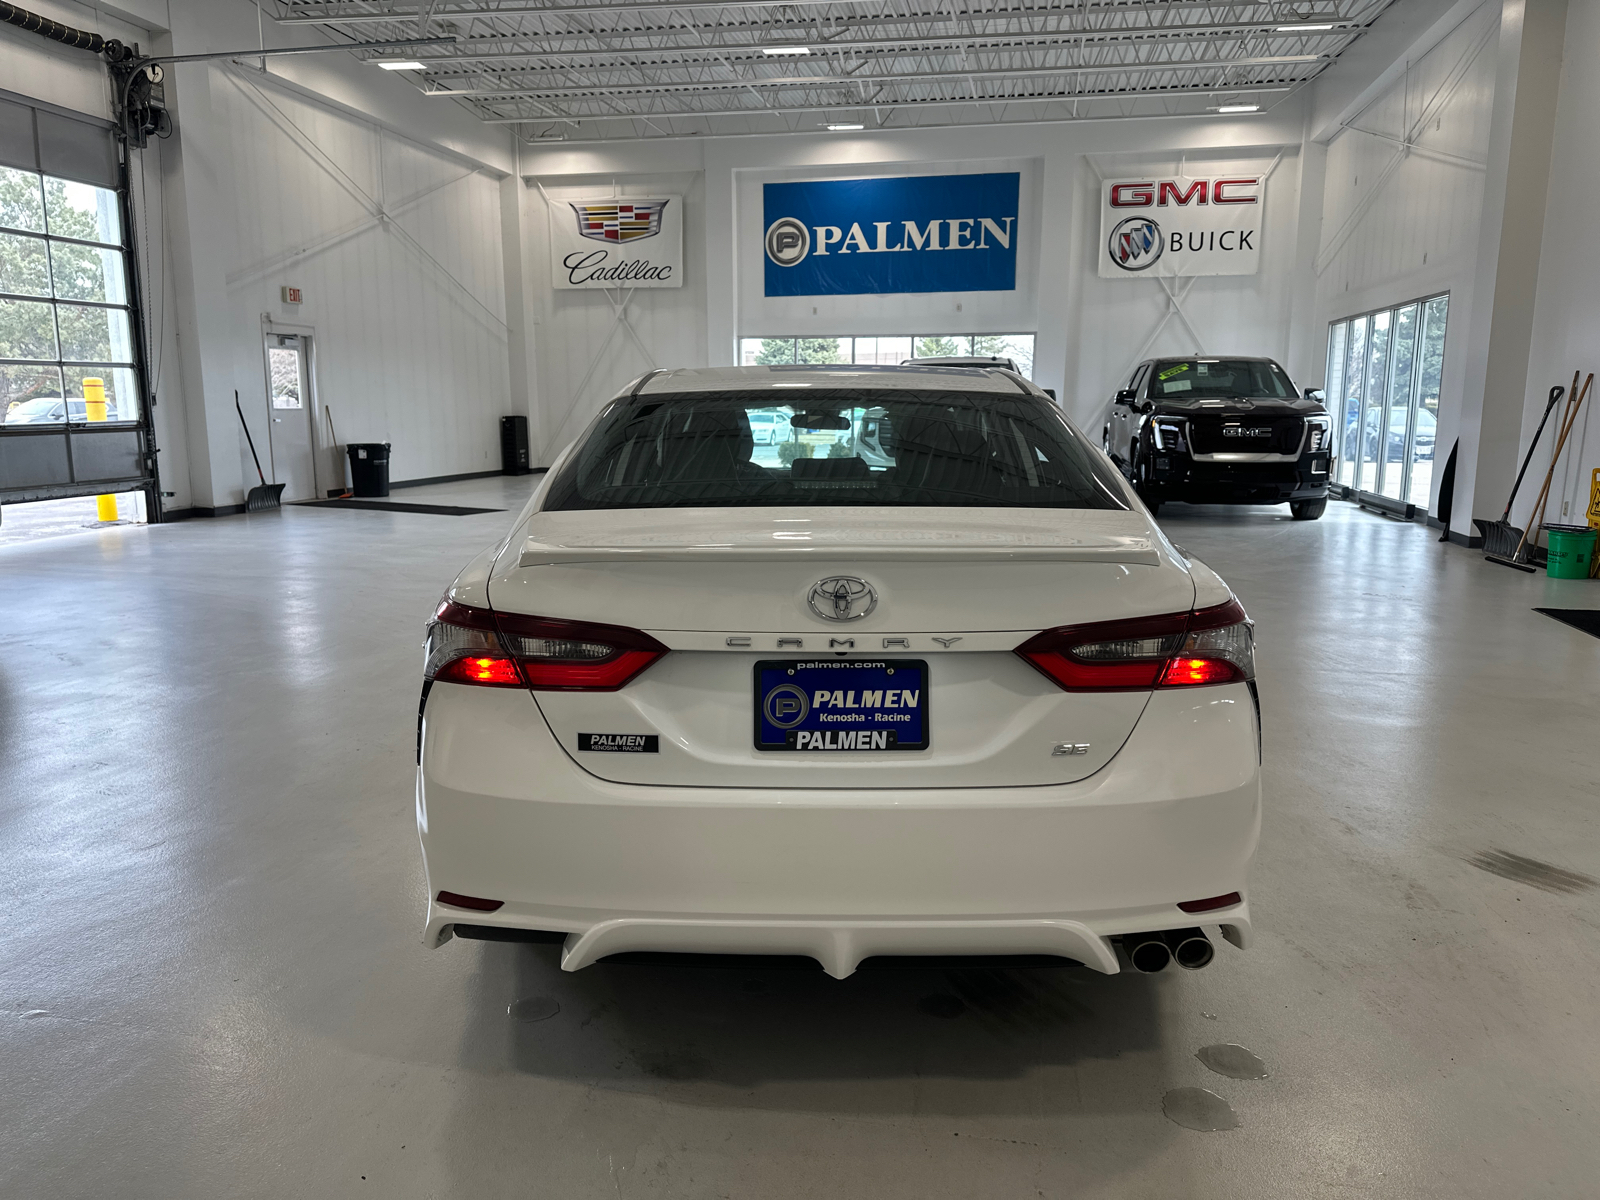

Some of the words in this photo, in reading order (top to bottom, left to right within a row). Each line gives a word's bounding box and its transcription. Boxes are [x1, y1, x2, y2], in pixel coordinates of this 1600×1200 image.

[1109, 177, 1260, 208] GMC
[777, 231, 801, 253] P
[812, 217, 1016, 256] PALMEN
[1170, 230, 1254, 252] BUICK
[563, 249, 672, 285] Cadillac
[289, 288, 300, 302] EXIT
[1223, 427, 1272, 437] GMC
[726, 636, 963, 649] CAMRY
[797, 661, 885, 670] palmen.com
[812, 689, 920, 709] PALMEN
[776, 698, 800, 717] P
[819, 713, 865, 722] Kenosha
[874, 713, 911, 722] Racine
[590, 735, 645, 746] PALMEN
[796, 731, 887, 750] PALMEN
[1051, 743, 1090, 756] SE
